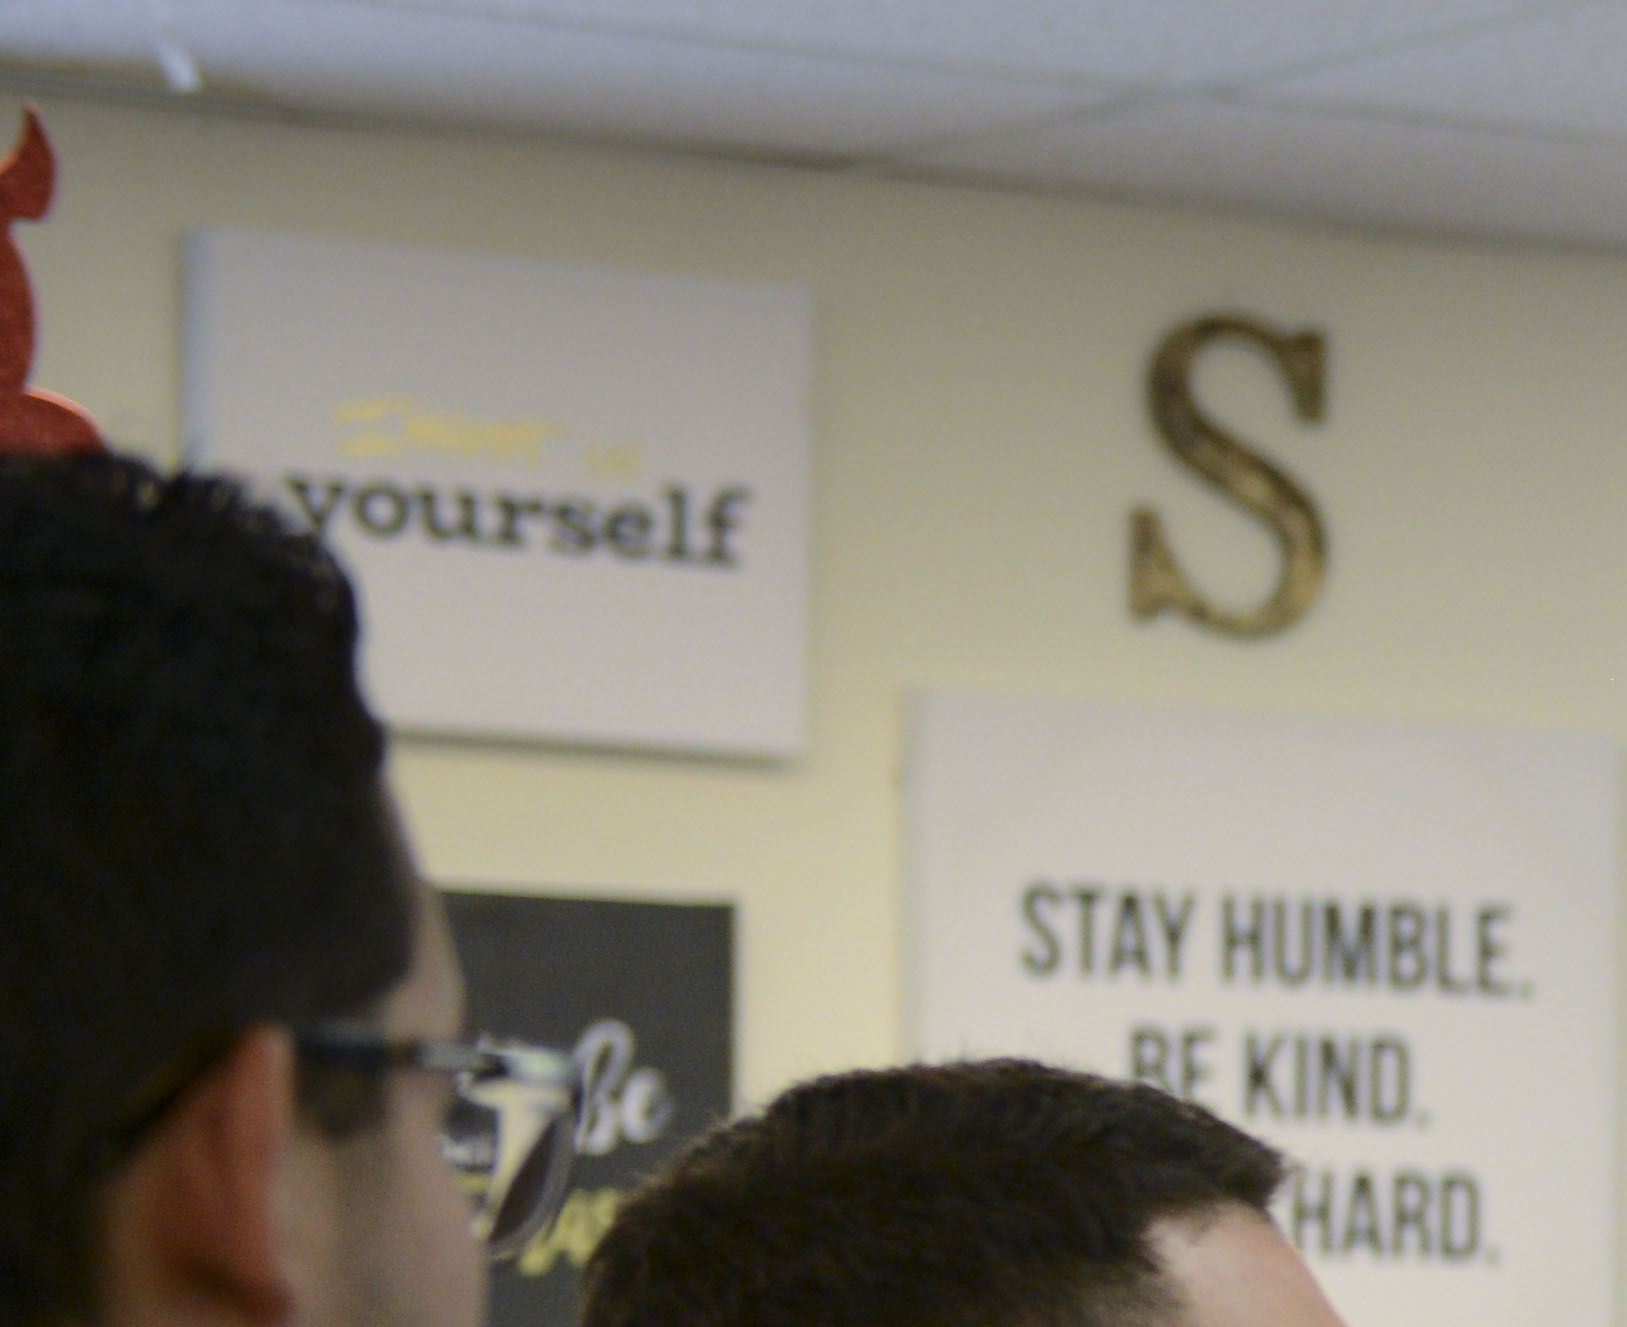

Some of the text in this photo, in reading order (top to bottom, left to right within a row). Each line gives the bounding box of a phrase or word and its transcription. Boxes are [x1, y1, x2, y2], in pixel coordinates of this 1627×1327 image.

[284, 468, 754, 570] yourself
[1127, 312, 1332, 642] S
[1018, 878, 1536, 1002] STAY HUMBLE.
[1240, 1026, 1434, 1132] KIND.
[1288, 1166, 1502, 1268] HARD.
